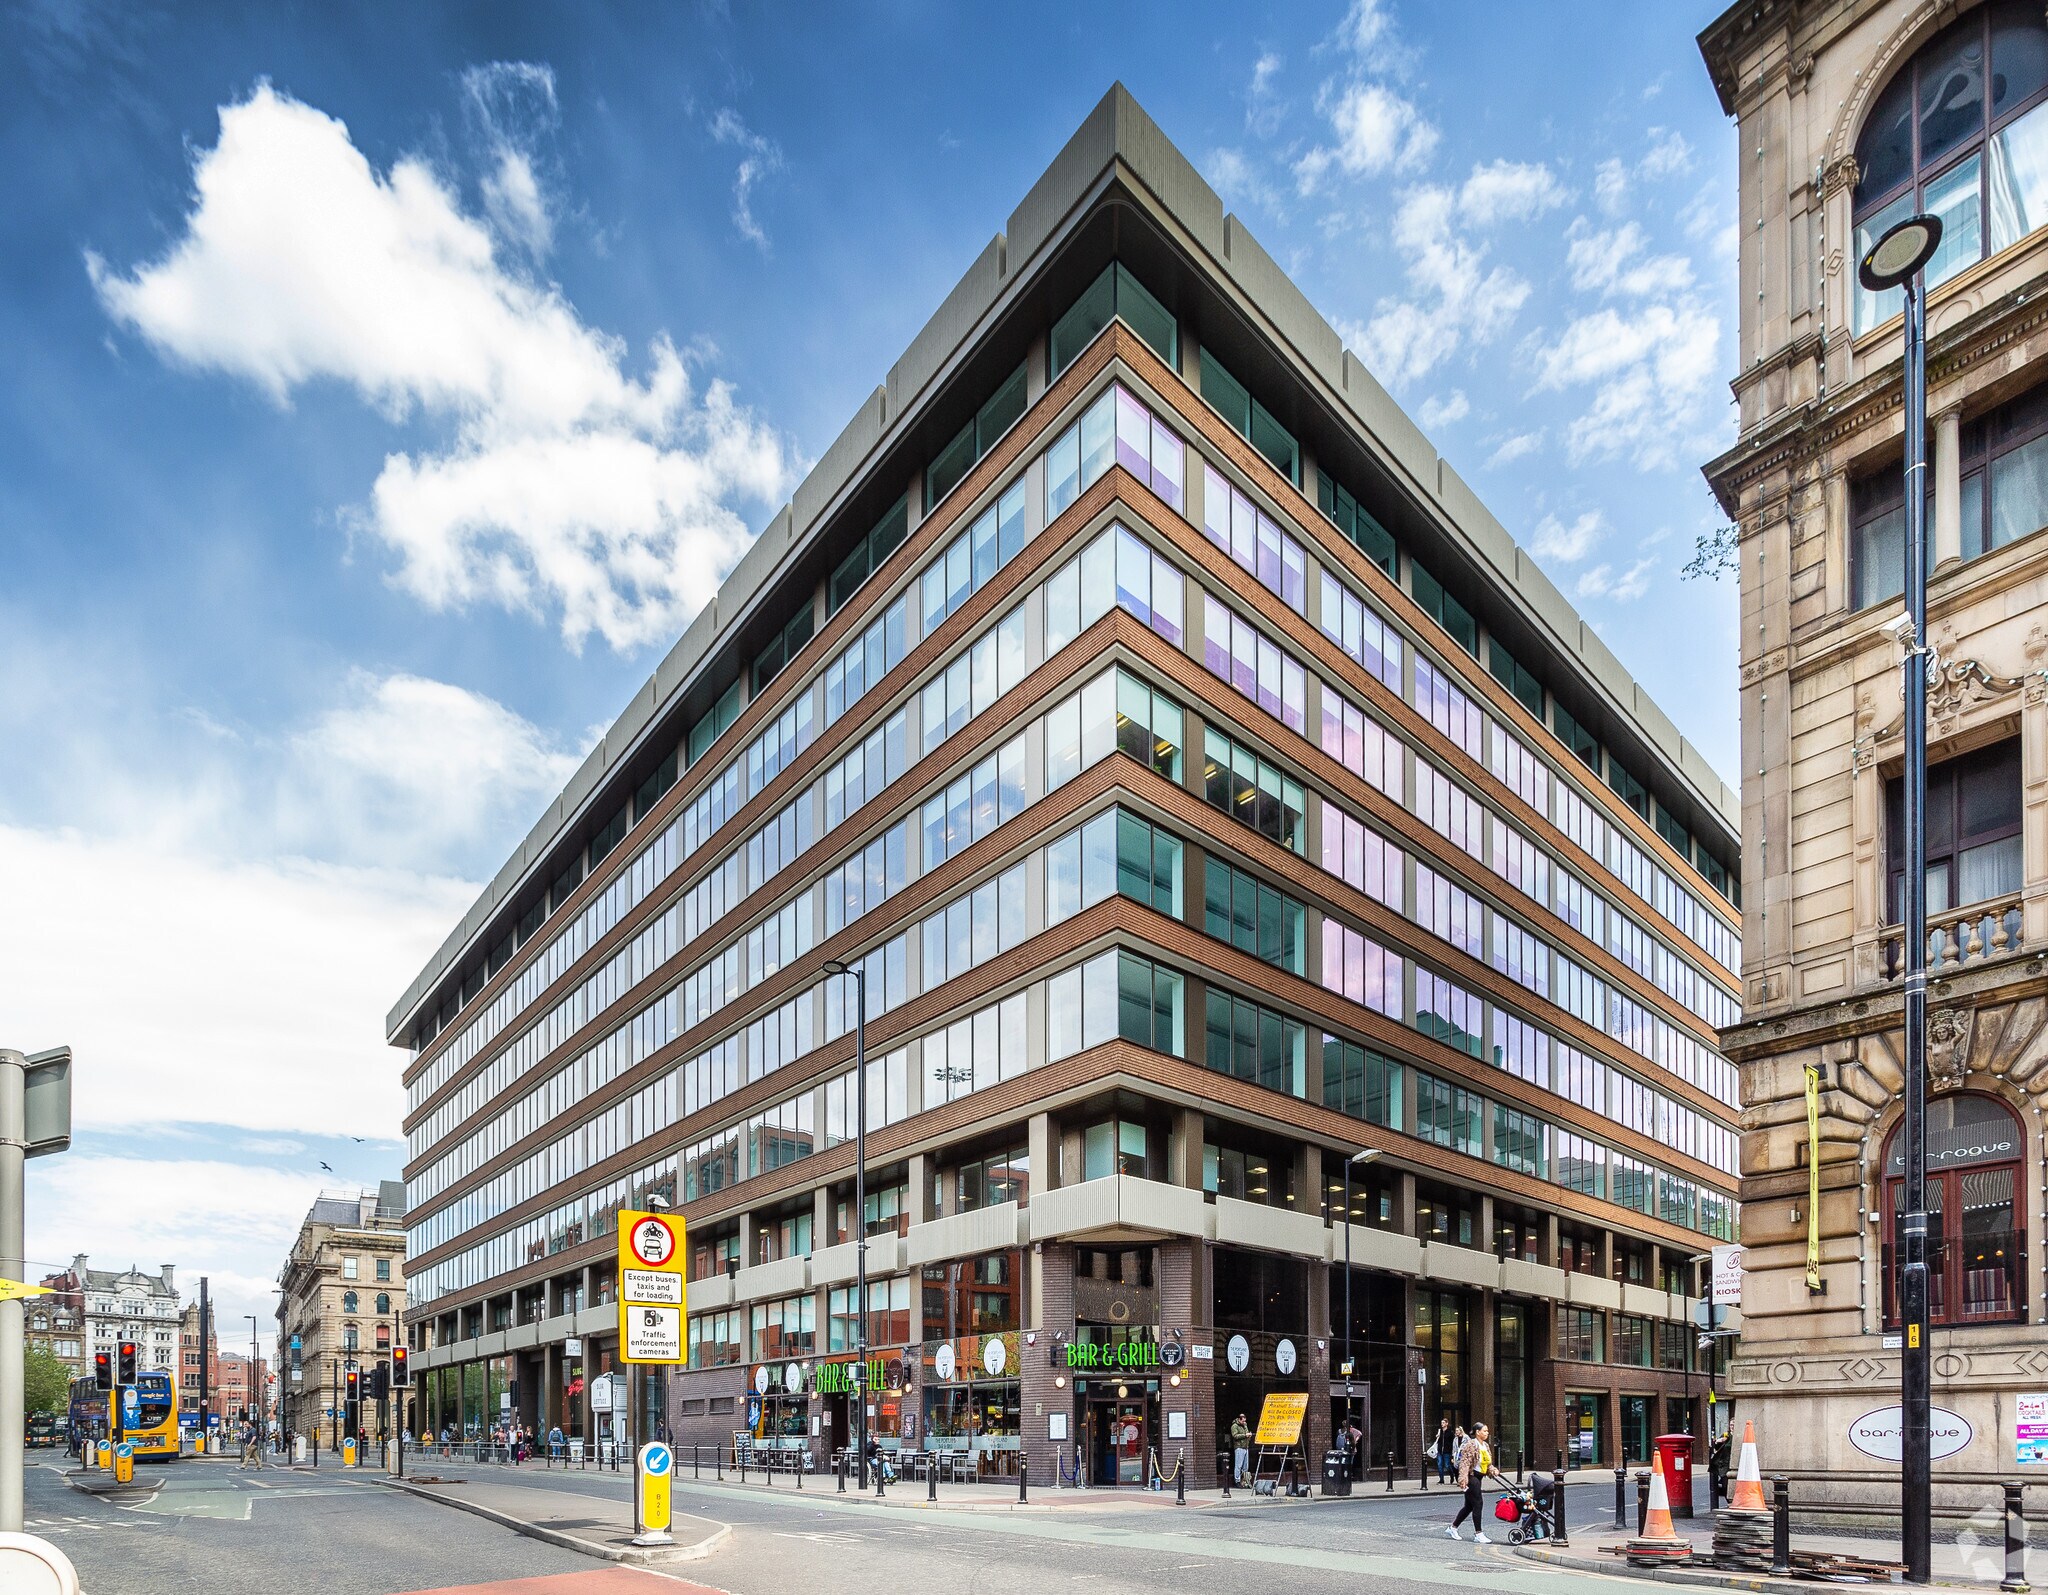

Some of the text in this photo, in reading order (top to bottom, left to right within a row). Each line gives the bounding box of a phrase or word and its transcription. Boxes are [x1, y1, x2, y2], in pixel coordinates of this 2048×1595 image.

[628, 1273, 653, 1282] Except
[646, 1291, 674, 1301] loading
[1716, 1287, 1741, 1296] KIOSK
[631, 1339, 677, 1348] enforcement
[1066, 1342, 1160, 1367] BAR & GRILL
[816, 1363, 839, 1393] BAR
[842, 1362, 850, 1392] &
